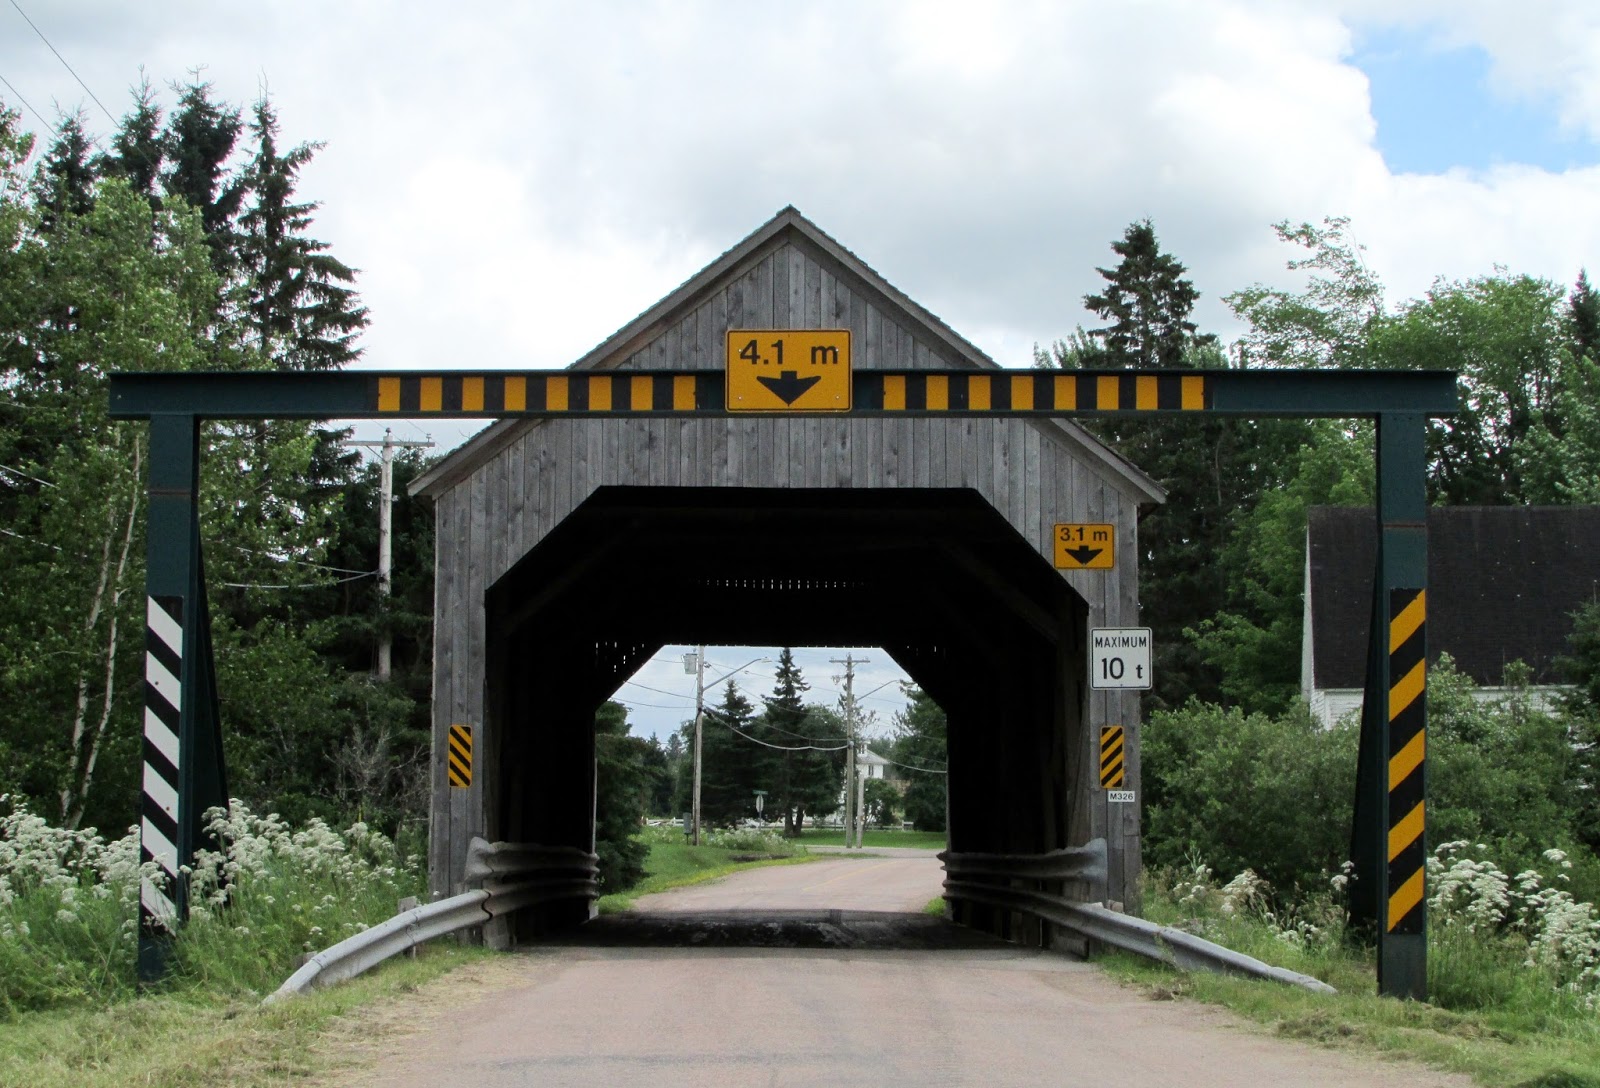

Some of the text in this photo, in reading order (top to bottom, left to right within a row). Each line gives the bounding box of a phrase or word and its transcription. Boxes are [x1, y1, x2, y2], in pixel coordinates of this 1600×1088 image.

[739, 339, 838, 365] 4.1 m
[1060, 527, 1108, 541] 3.1 m
[1095, 636, 1147, 648] MAXIMUM
[1101, 657, 1143, 680] 10 t
[1110, 792, 1134, 801] M326
